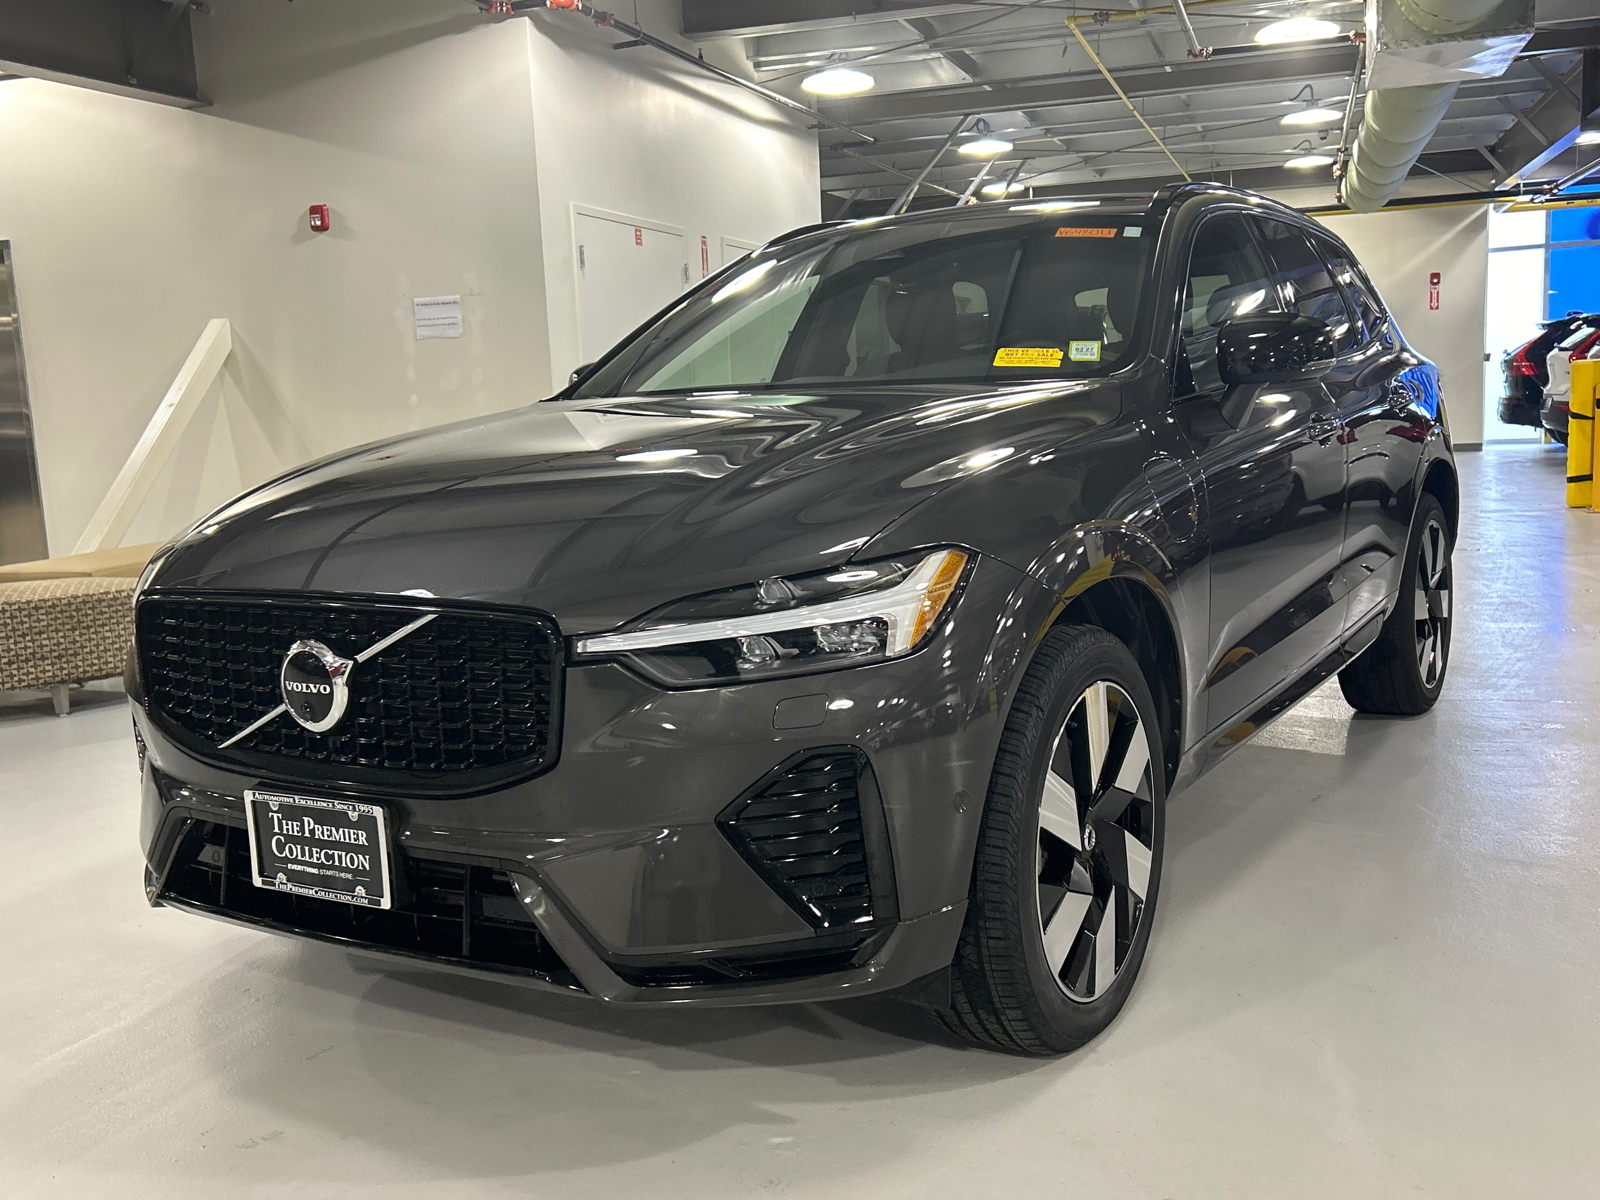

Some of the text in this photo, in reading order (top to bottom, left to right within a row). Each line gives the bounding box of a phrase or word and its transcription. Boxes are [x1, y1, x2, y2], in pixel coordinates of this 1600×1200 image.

[285, 680, 331, 695] VOLVO
[354, 804, 373, 814] 1995
[268, 812, 369, 846] THE PREMIER
[271, 835, 370, 871] COLLECTION
[287, 863, 319, 875] EVERYTHING
[319, 869, 339, 878] STARTS
